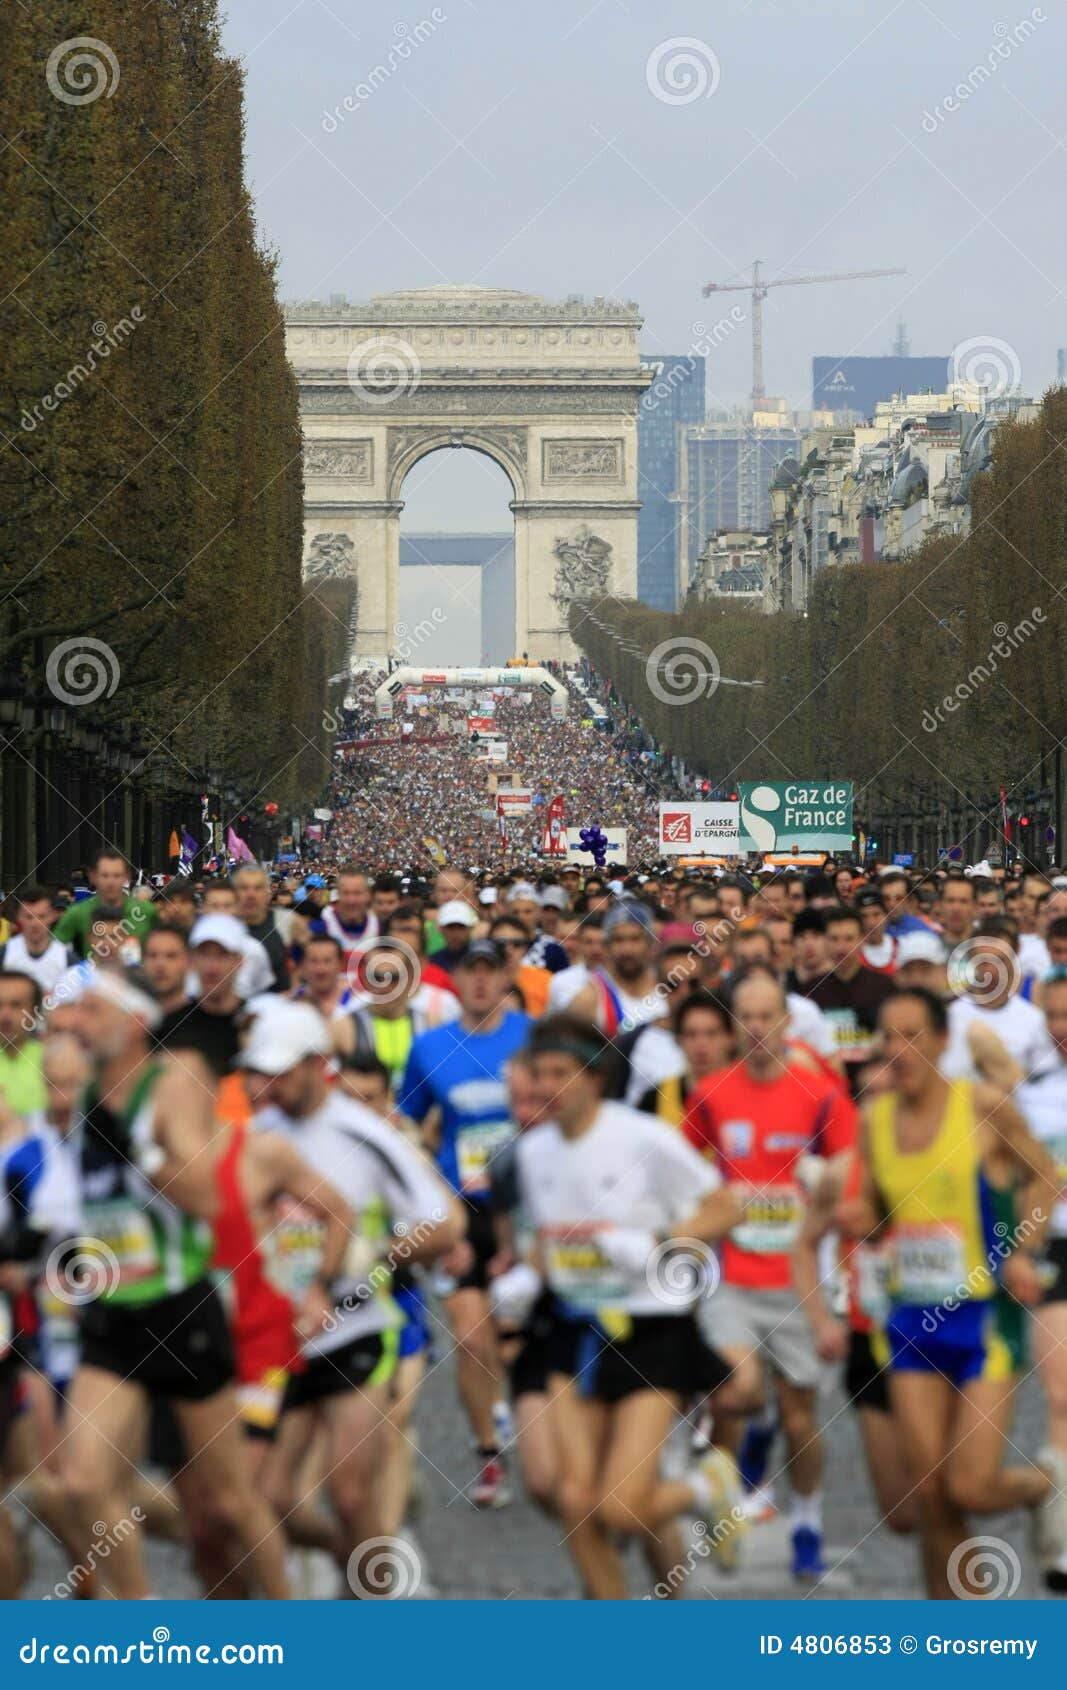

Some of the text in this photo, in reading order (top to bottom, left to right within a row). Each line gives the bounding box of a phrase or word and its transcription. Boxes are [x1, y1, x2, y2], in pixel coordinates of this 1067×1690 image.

[784, 786, 847, 805] Gaz de
[704, 819, 734, 827] CAISSE
[784, 808, 846, 827] France
